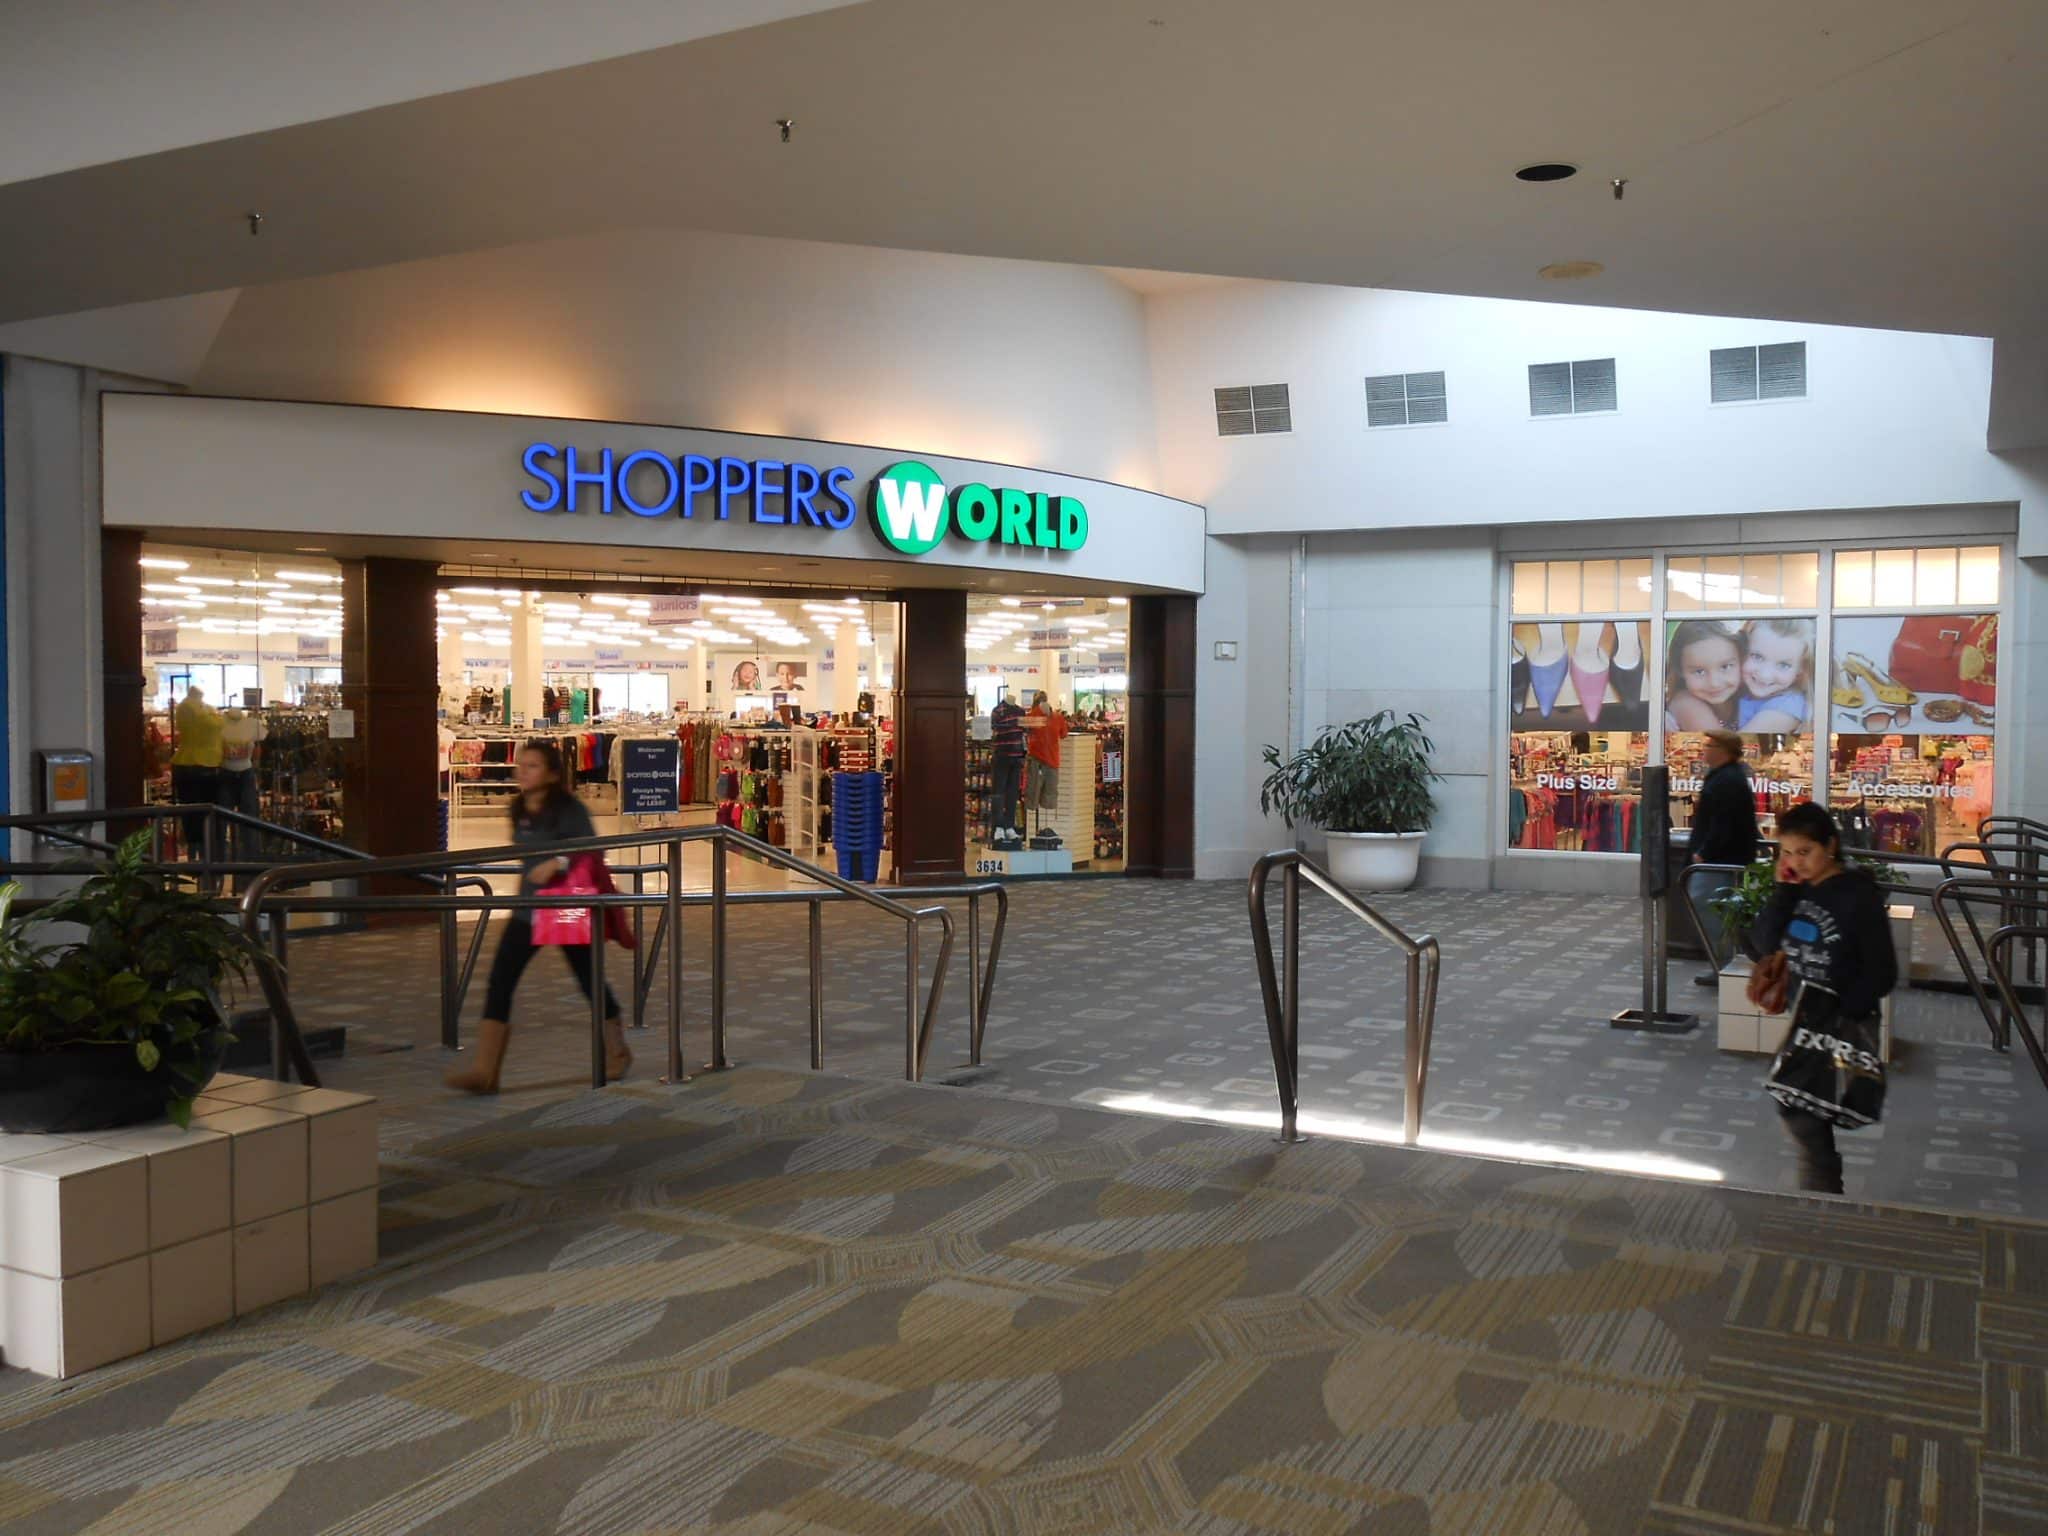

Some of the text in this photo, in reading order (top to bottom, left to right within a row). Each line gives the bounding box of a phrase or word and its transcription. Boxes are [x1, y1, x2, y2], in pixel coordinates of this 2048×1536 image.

[520, 442, 1089, 551] SHOPPERS WORLD
[1536, 774, 1617, 791] Plus Size
[1847, 780, 1976, 798] Accessories
[976, 860, 1003, 873] 3634
